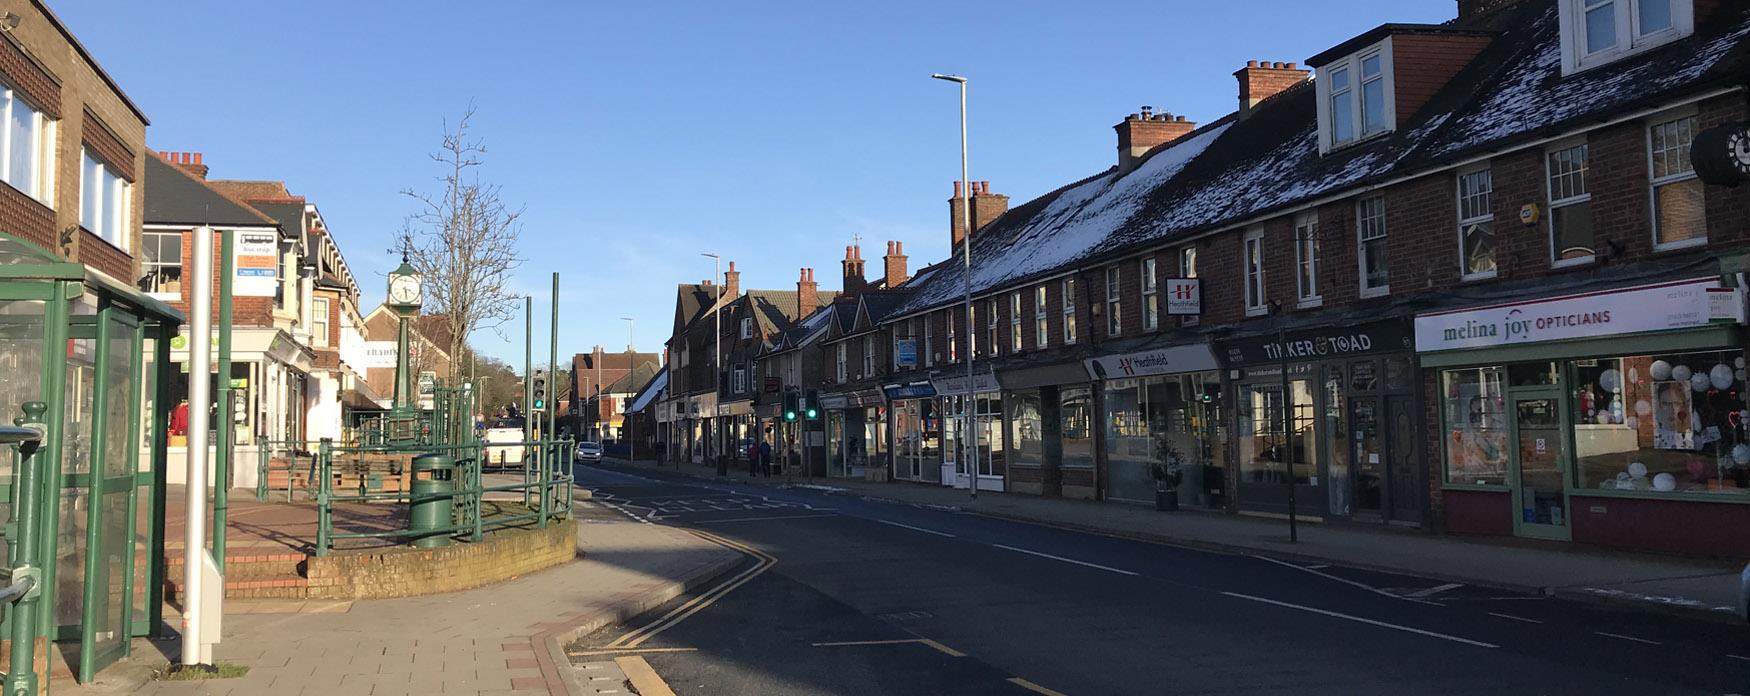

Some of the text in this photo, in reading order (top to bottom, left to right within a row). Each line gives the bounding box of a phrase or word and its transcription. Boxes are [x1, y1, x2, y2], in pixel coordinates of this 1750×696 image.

[1443, 310, 1611, 341] melina joy OPTICIANS
[1328, 334, 1372, 352] TOAD
